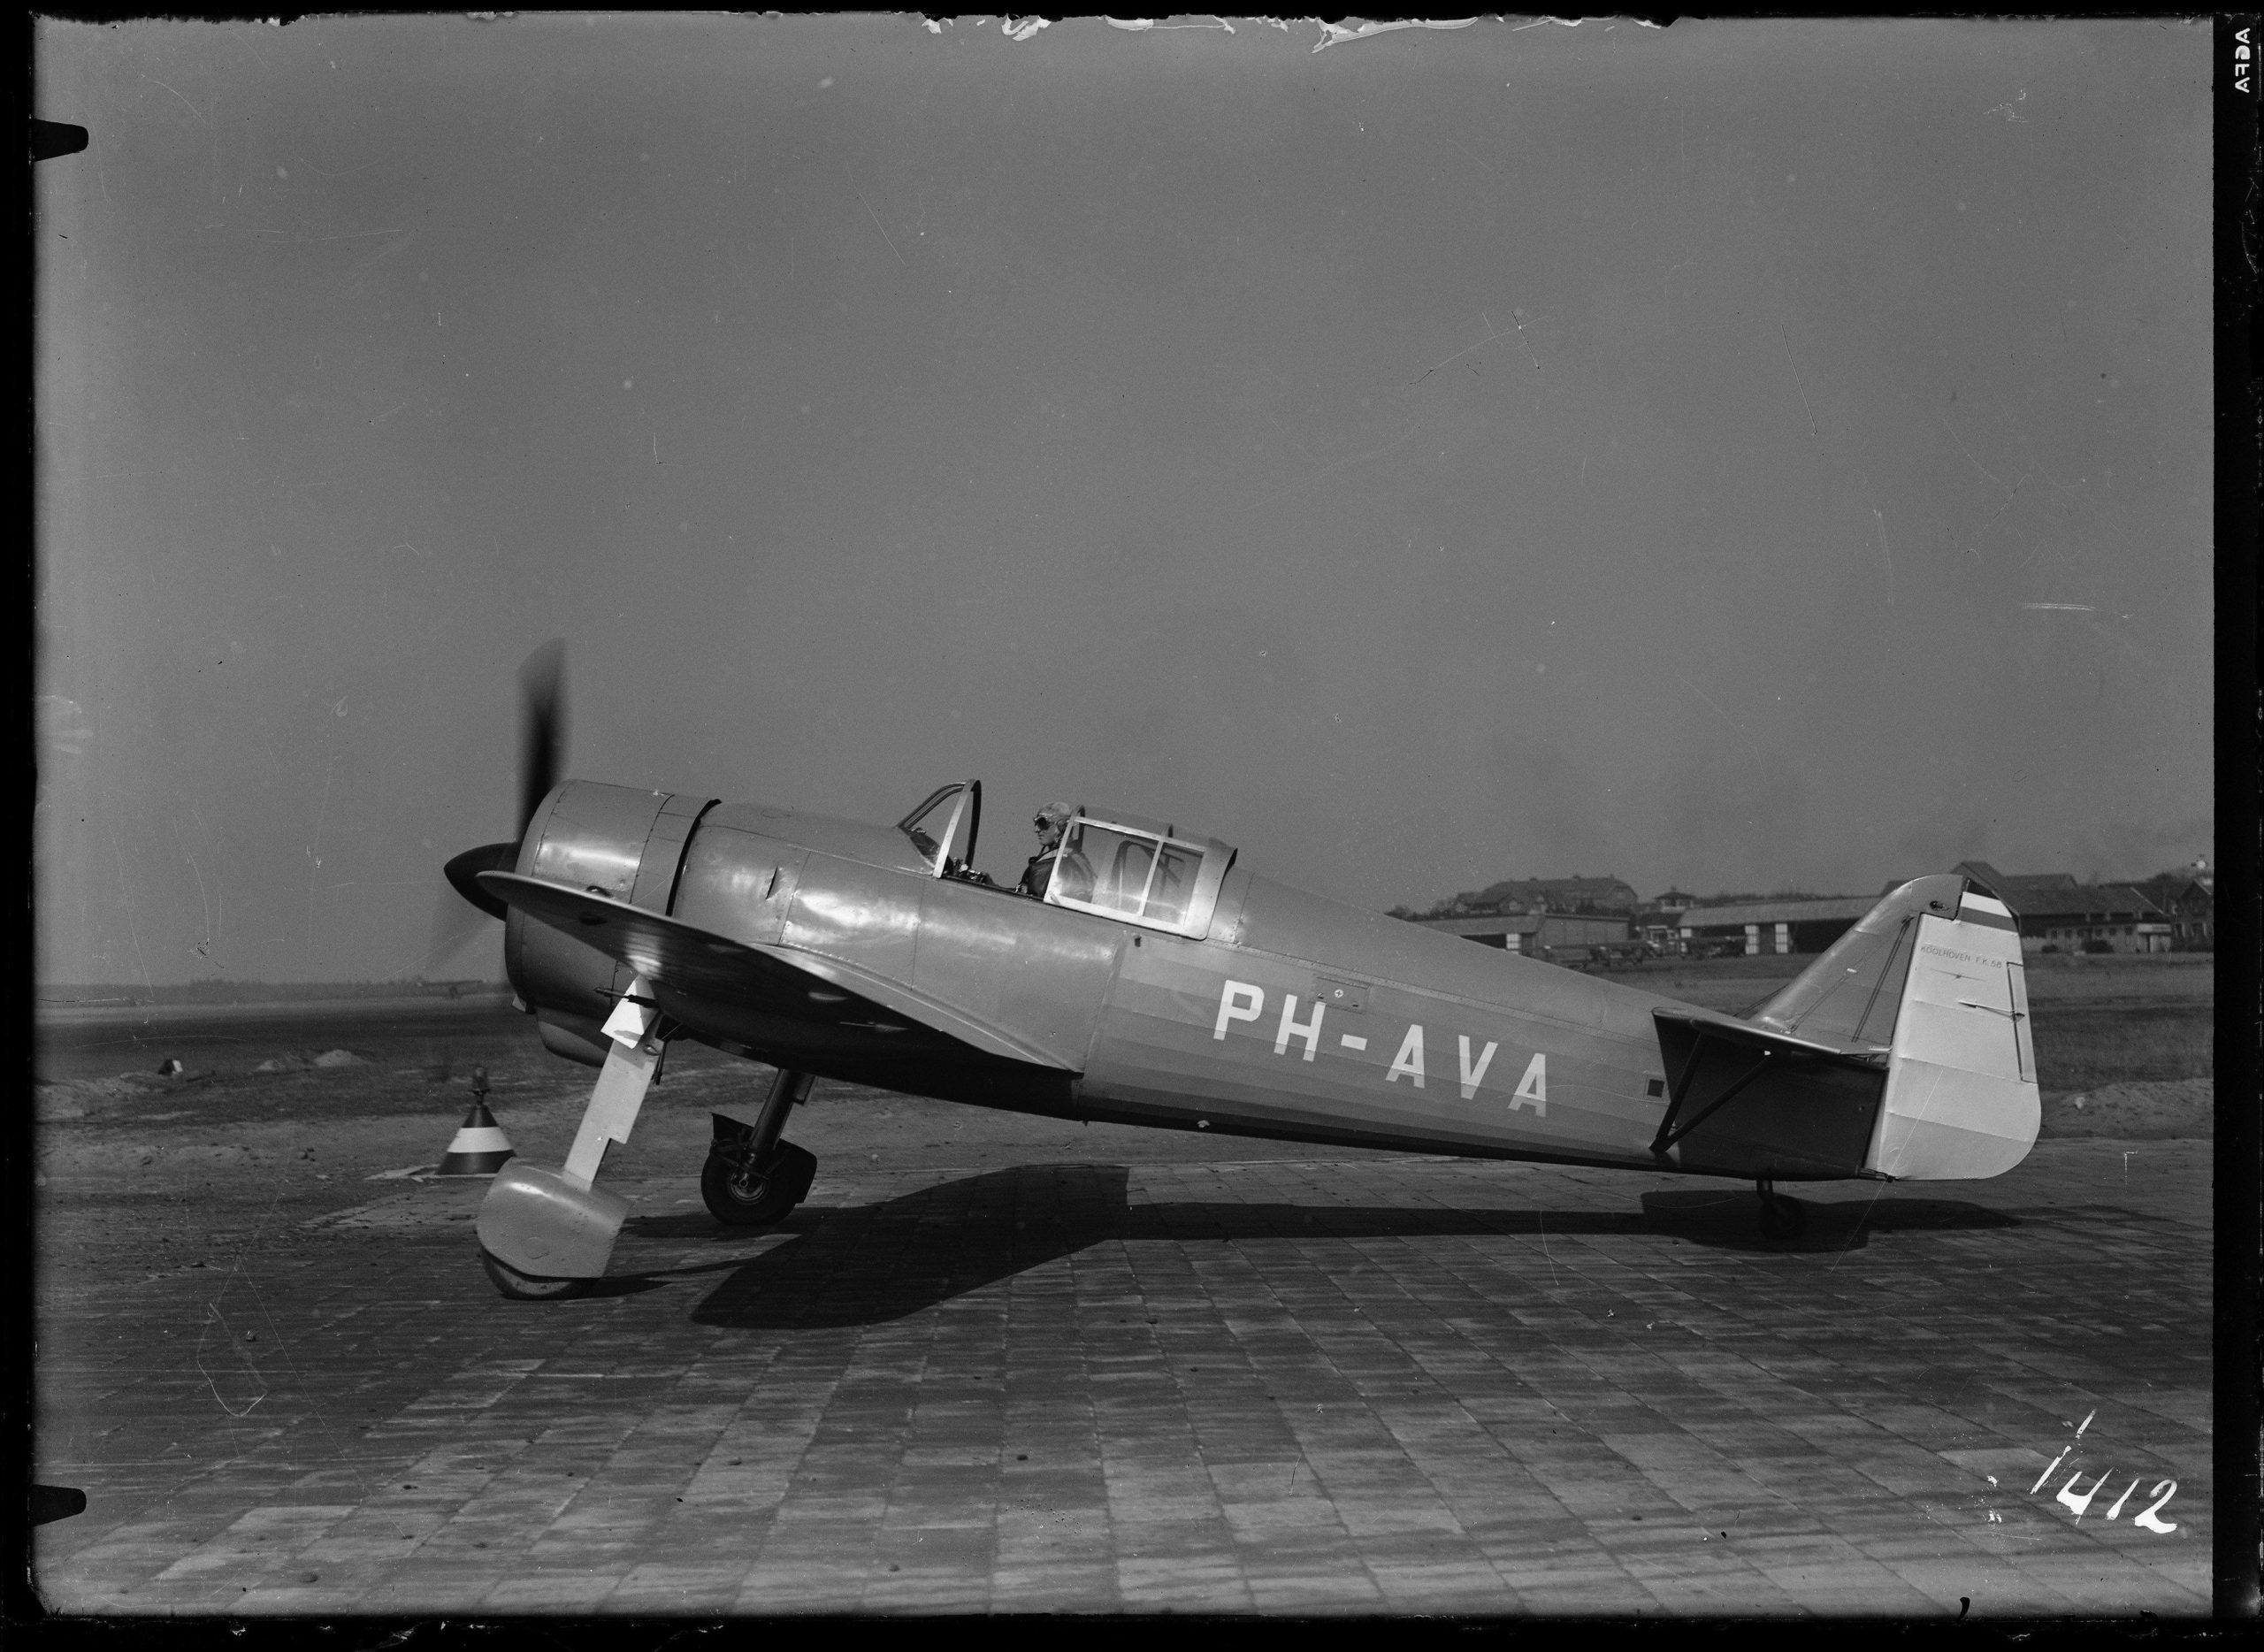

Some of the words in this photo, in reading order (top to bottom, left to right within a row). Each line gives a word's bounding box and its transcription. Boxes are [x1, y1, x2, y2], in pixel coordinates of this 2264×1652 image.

[1920, 945, 1970, 962] KOOLHOVEN
[1213, 979, 1547, 1117] PH-AVA
[2030, 1409, 2177, 1534] 1412
